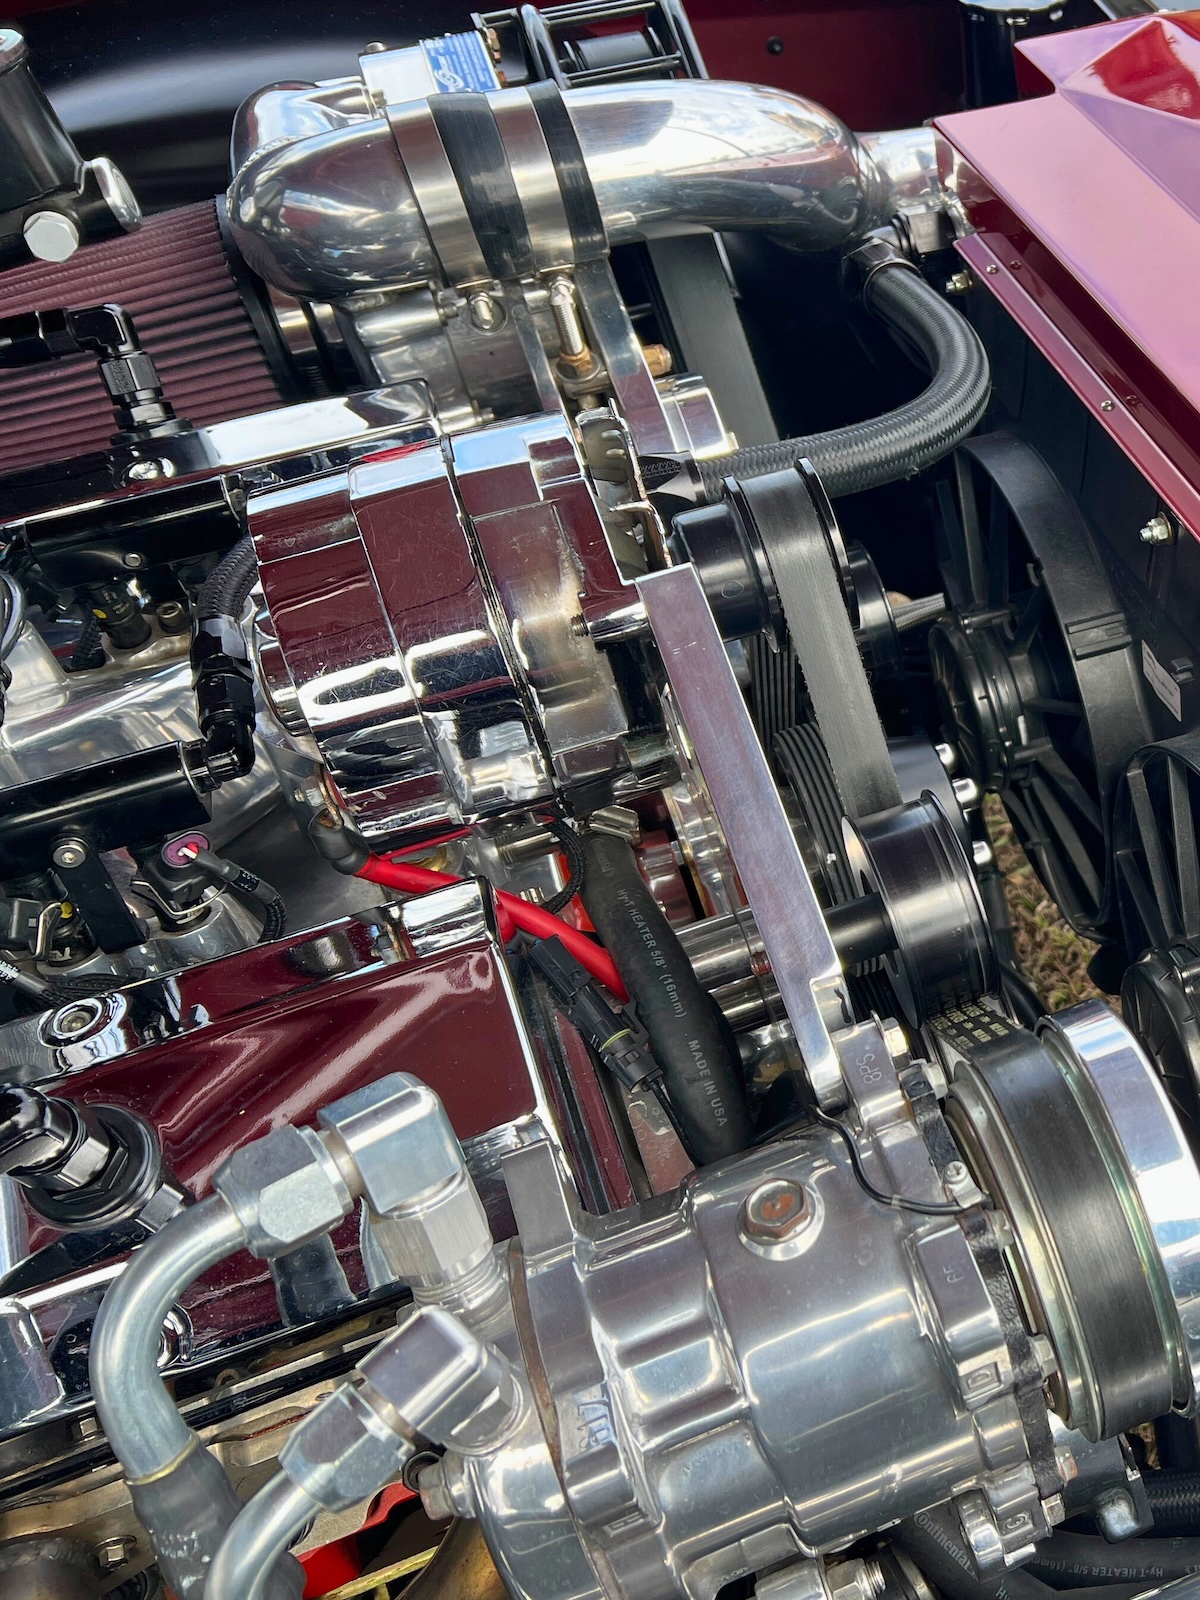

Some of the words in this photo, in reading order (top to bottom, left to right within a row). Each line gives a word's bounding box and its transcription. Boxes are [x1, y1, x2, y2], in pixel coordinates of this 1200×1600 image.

[628, 908, 657, 949] HEATER
[658, 973, 688, 1019] (16mm)
[688, 1039, 711, 1077] MADE
[703, 1080, 718, 1095] IN
[710, 1097, 728, 1127] USA
[913, 1509, 972, 1572] Continental
[1091, 1566, 1137, 1578] HEATER
[1139, 1566, 1164, 1578] Hy-T
